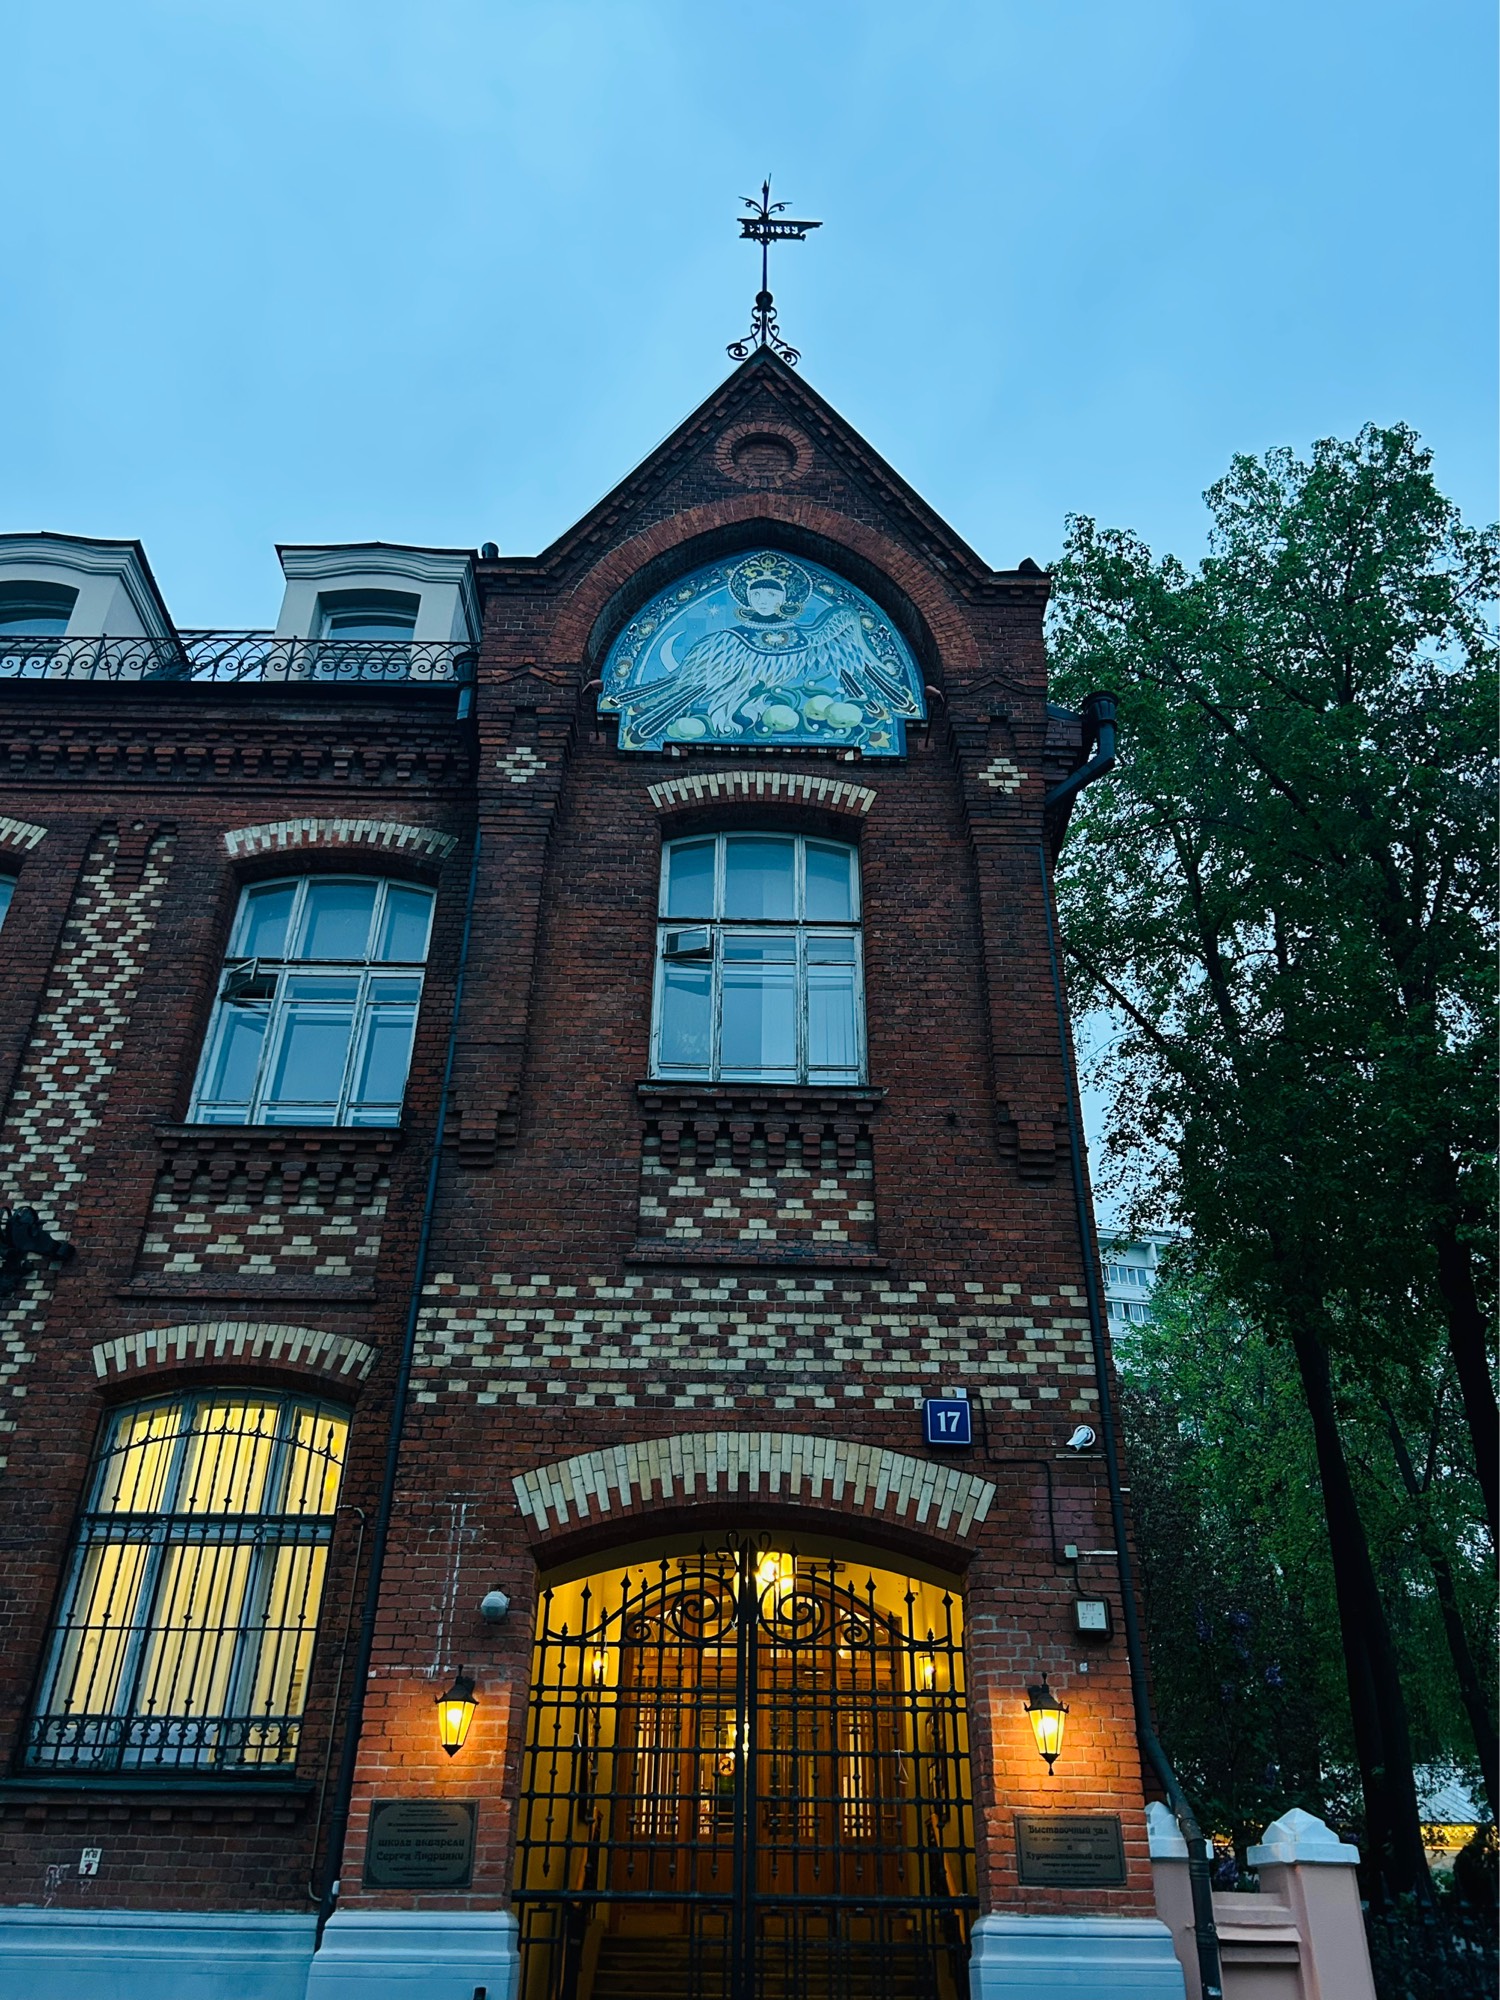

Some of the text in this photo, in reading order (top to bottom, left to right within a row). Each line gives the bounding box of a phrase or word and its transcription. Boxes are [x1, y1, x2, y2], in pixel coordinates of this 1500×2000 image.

[937, 1411, 961, 1432] 17
[1027, 1825, 1109, 1836] Выставочный зал
[415, 1839, 465, 1849] акварели
[376, 1851, 412, 1863] Сергея
[1026, 1851, 1093, 1861] Художественный
